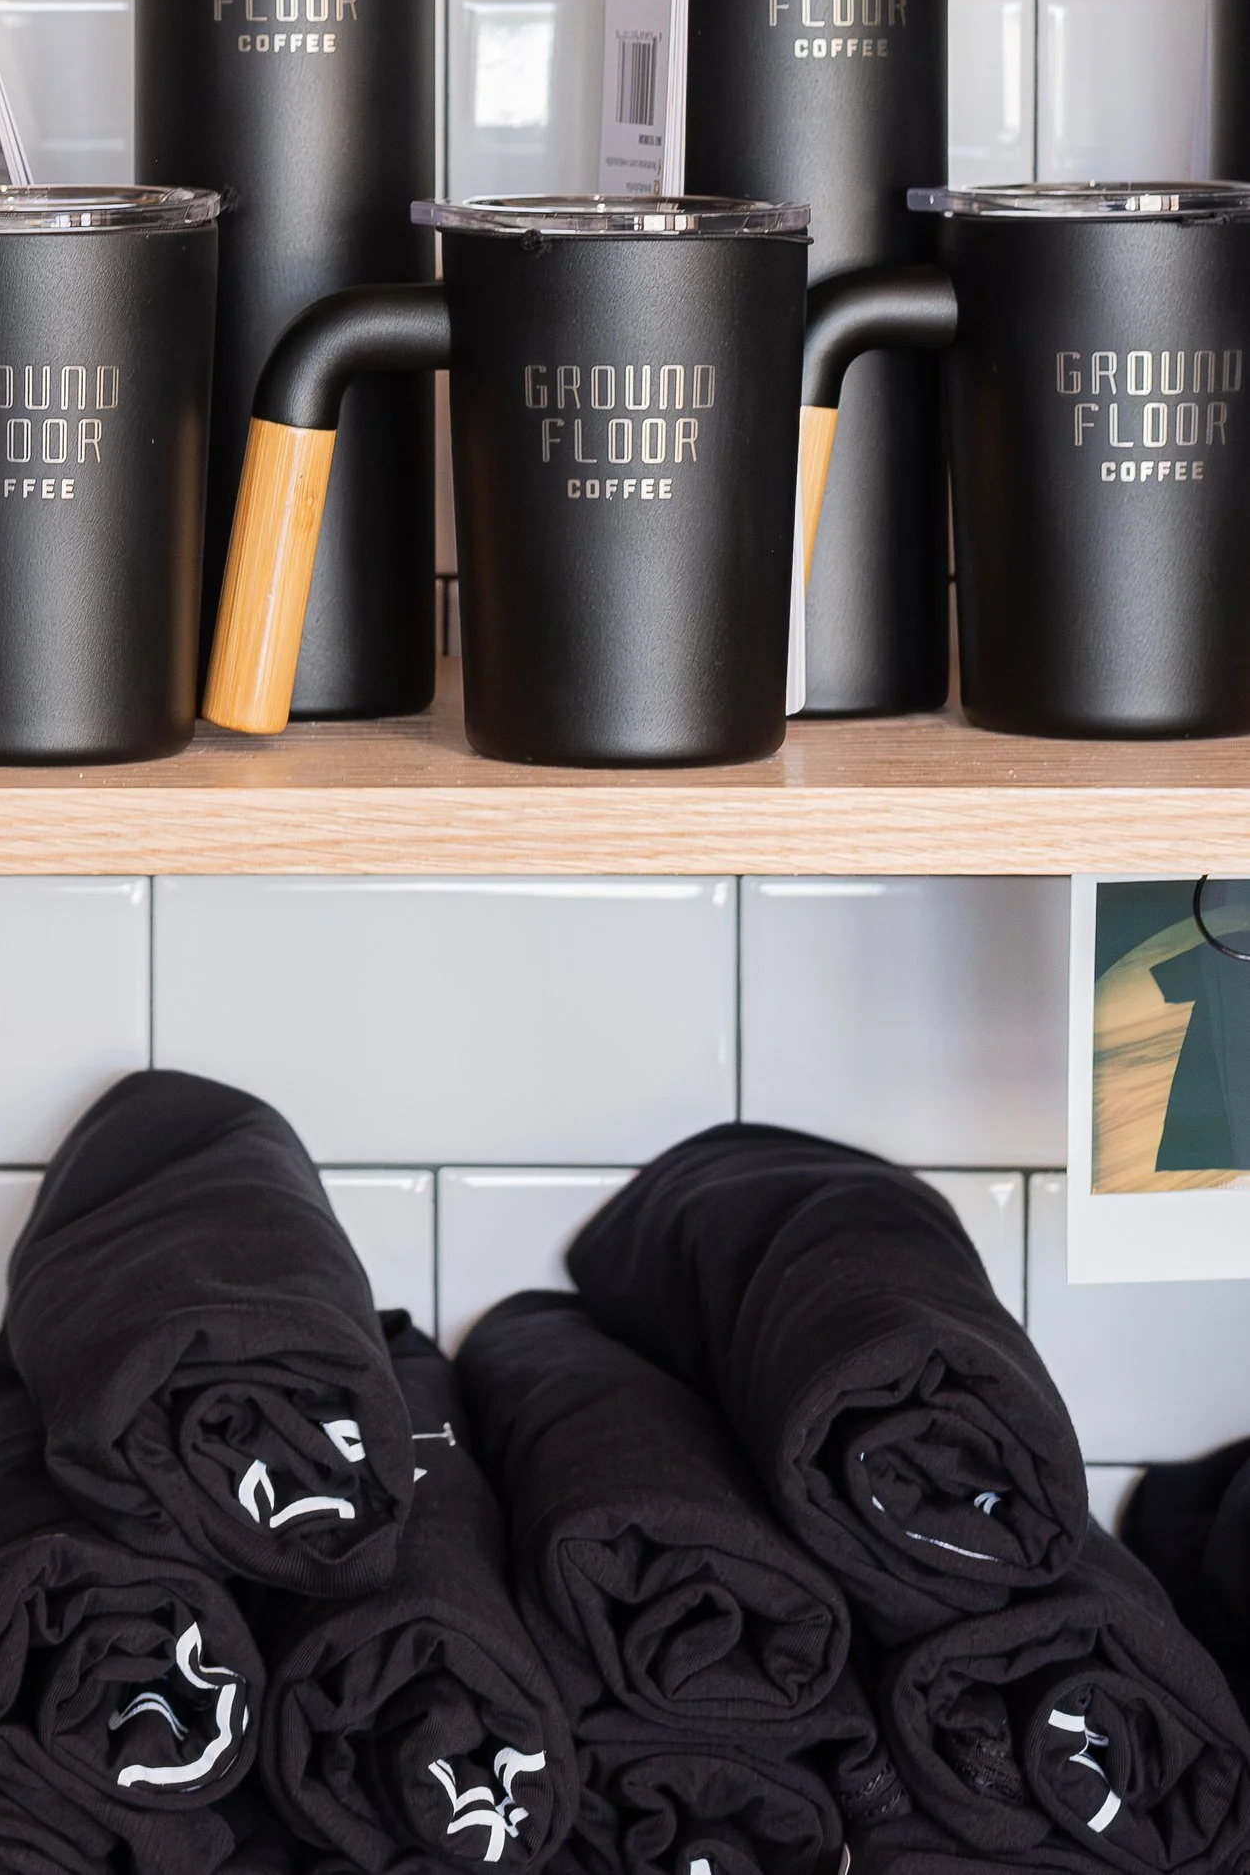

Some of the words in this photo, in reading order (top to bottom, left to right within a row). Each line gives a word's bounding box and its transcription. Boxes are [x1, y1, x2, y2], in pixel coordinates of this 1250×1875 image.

[237, 33, 336, 53] COFFEE
[794, 38, 888, 59] COFFEE
[525, 365, 715, 410] GROUND
[1057, 351, 1240, 395] GROUND
[542, 418, 698, 463] FLOOR
[1075, 403, 1226, 447] FLOOR
[1102, 461, 1203, 482] COFFEE
[568, 479, 672, 500] COFFEE
